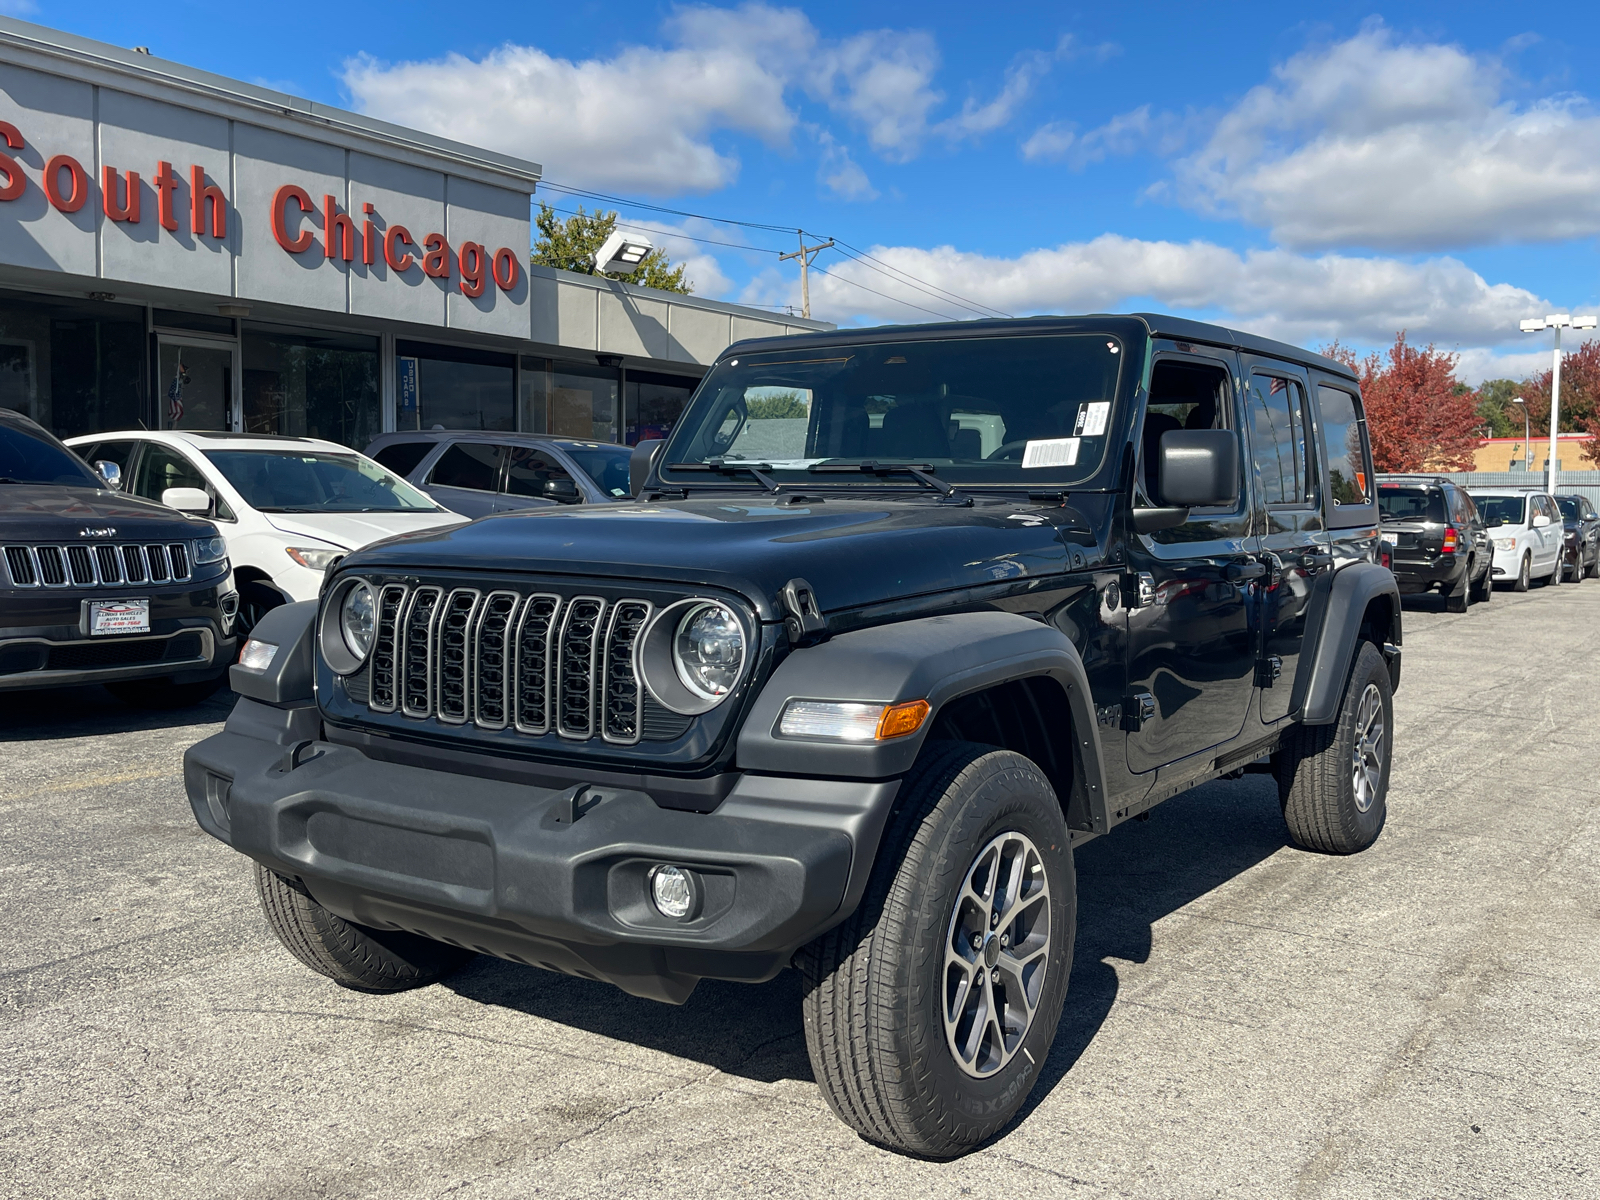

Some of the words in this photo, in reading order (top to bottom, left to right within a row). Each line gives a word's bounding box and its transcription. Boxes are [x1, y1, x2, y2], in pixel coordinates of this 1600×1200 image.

[0, 120, 226, 239] South
[271, 184, 519, 298] Chicago
[79, 527, 117, 538] Jeep
